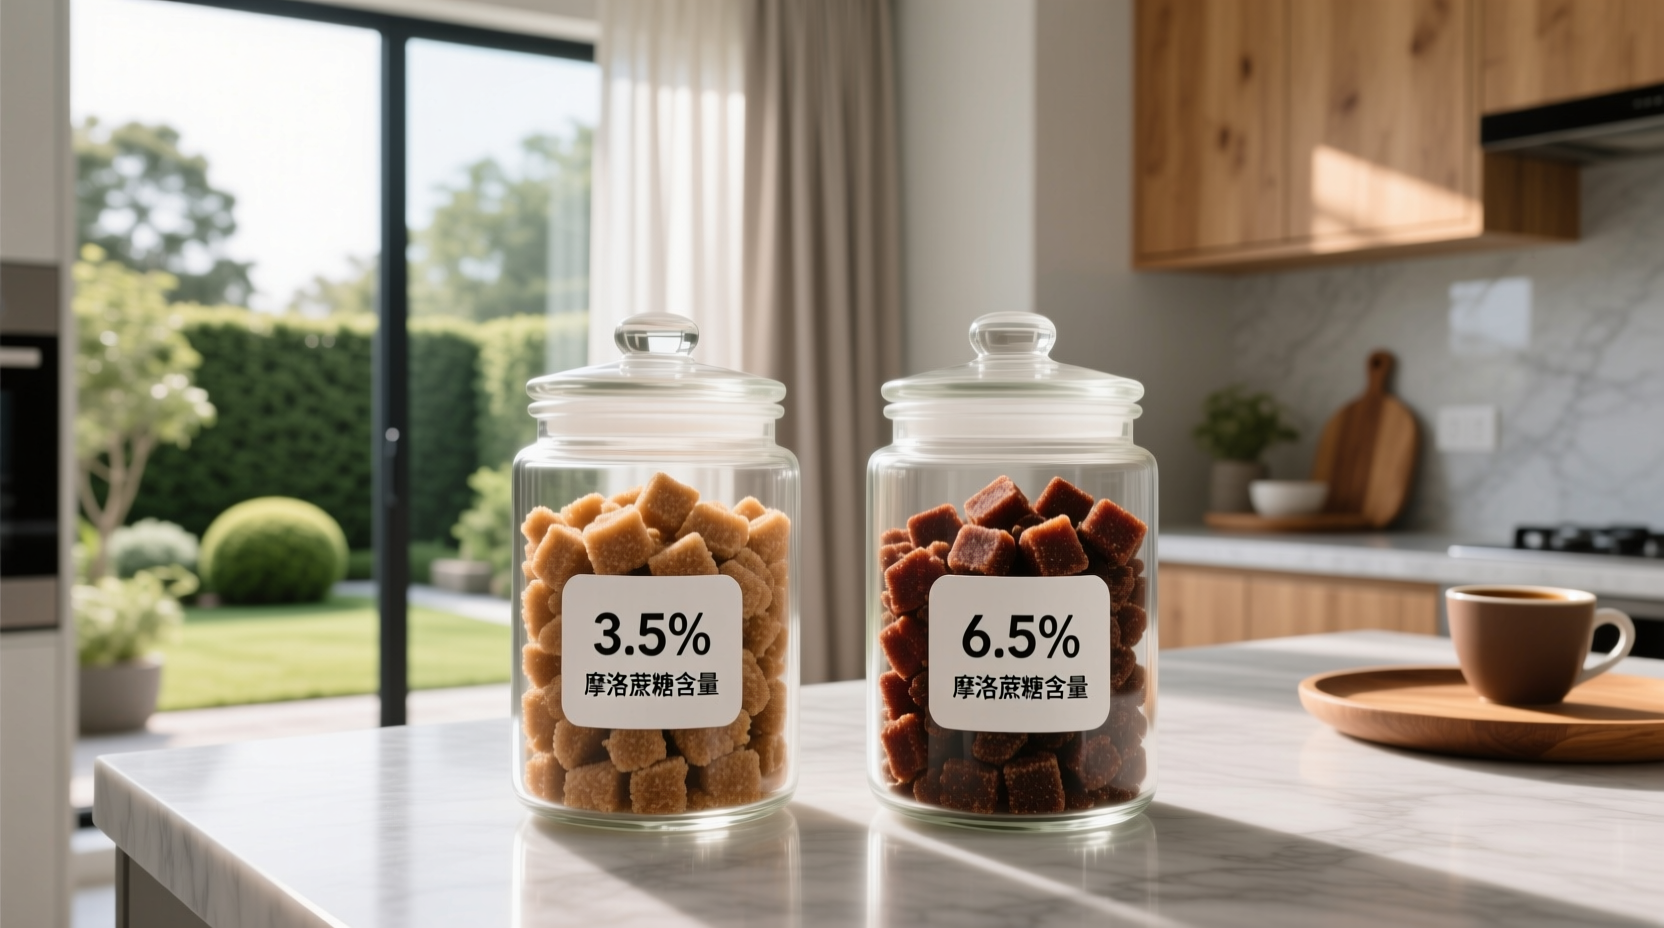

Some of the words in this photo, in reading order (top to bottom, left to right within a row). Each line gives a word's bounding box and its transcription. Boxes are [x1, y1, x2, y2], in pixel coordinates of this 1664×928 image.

[593, 611, 711, 657] 3.5%
[961, 614, 1080, 659] 6.5%
[584, 671, 719, 698] 摩洛蔗糖含量
[952, 674, 1089, 701] 摩洛蔗糖含量
